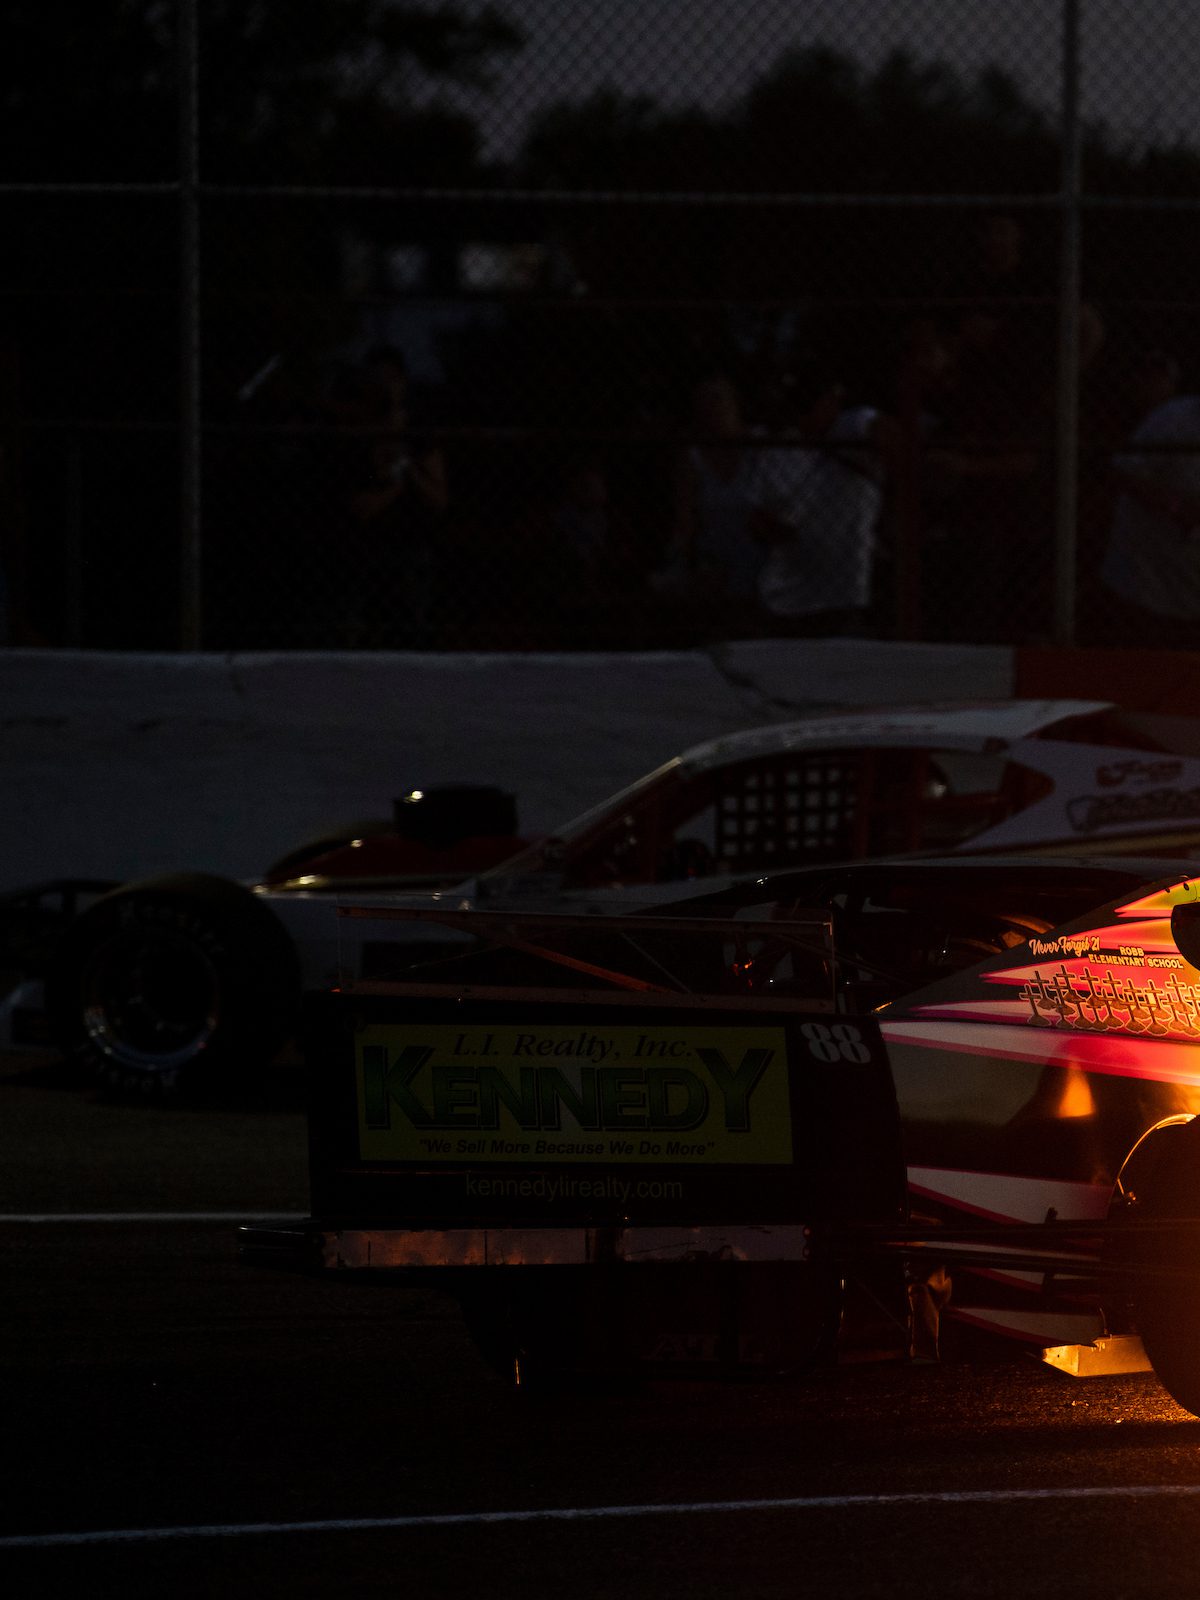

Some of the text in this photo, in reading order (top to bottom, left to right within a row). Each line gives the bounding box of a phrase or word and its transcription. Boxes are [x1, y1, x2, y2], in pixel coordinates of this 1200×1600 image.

[1029, 936, 1100, 957] Never Forget 21
[1119, 946, 1144, 957] ROBB
[1088, 953, 1184, 969] ELEMENTARY SCHOOL
[452, 1033, 692, 1063] L.I. Realty, Inc.
[801, 1023, 872, 1064] 88
[364, 1045, 775, 1133] KENNEDY
[419, 1140, 715, 1155] "We Sell More Because We Do More"
[465, 1172, 685, 1202] kennedylirealty.com
